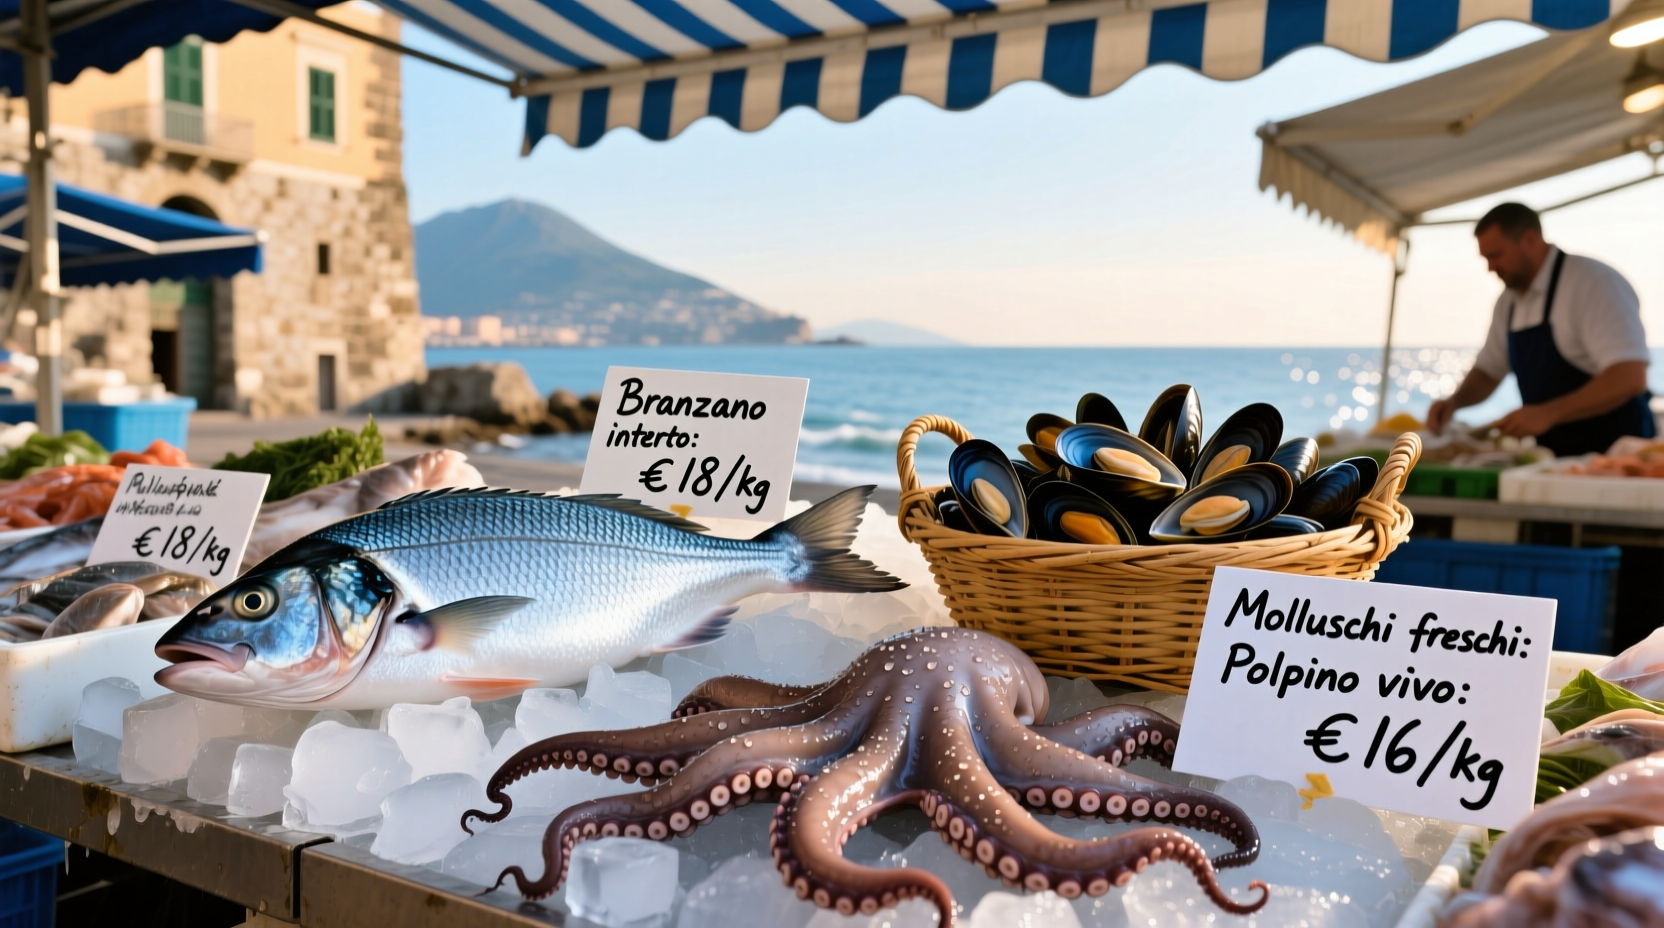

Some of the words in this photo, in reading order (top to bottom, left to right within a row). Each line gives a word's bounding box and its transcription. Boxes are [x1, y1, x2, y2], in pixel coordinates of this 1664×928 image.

[616, 377, 767, 421] Branzano
[606, 421, 700, 449] interto:
[638, 454, 771, 515] €18/kg
[131, 525, 231, 577] €18/kg
[1224, 587, 1397, 643] Molluschi
[1408, 611, 1532, 659] freschi:
[1220, 642, 1360, 699] Polpino
[1378, 666, 1471, 705] vivo:
[1303, 712, 1504, 811] €16/kg
